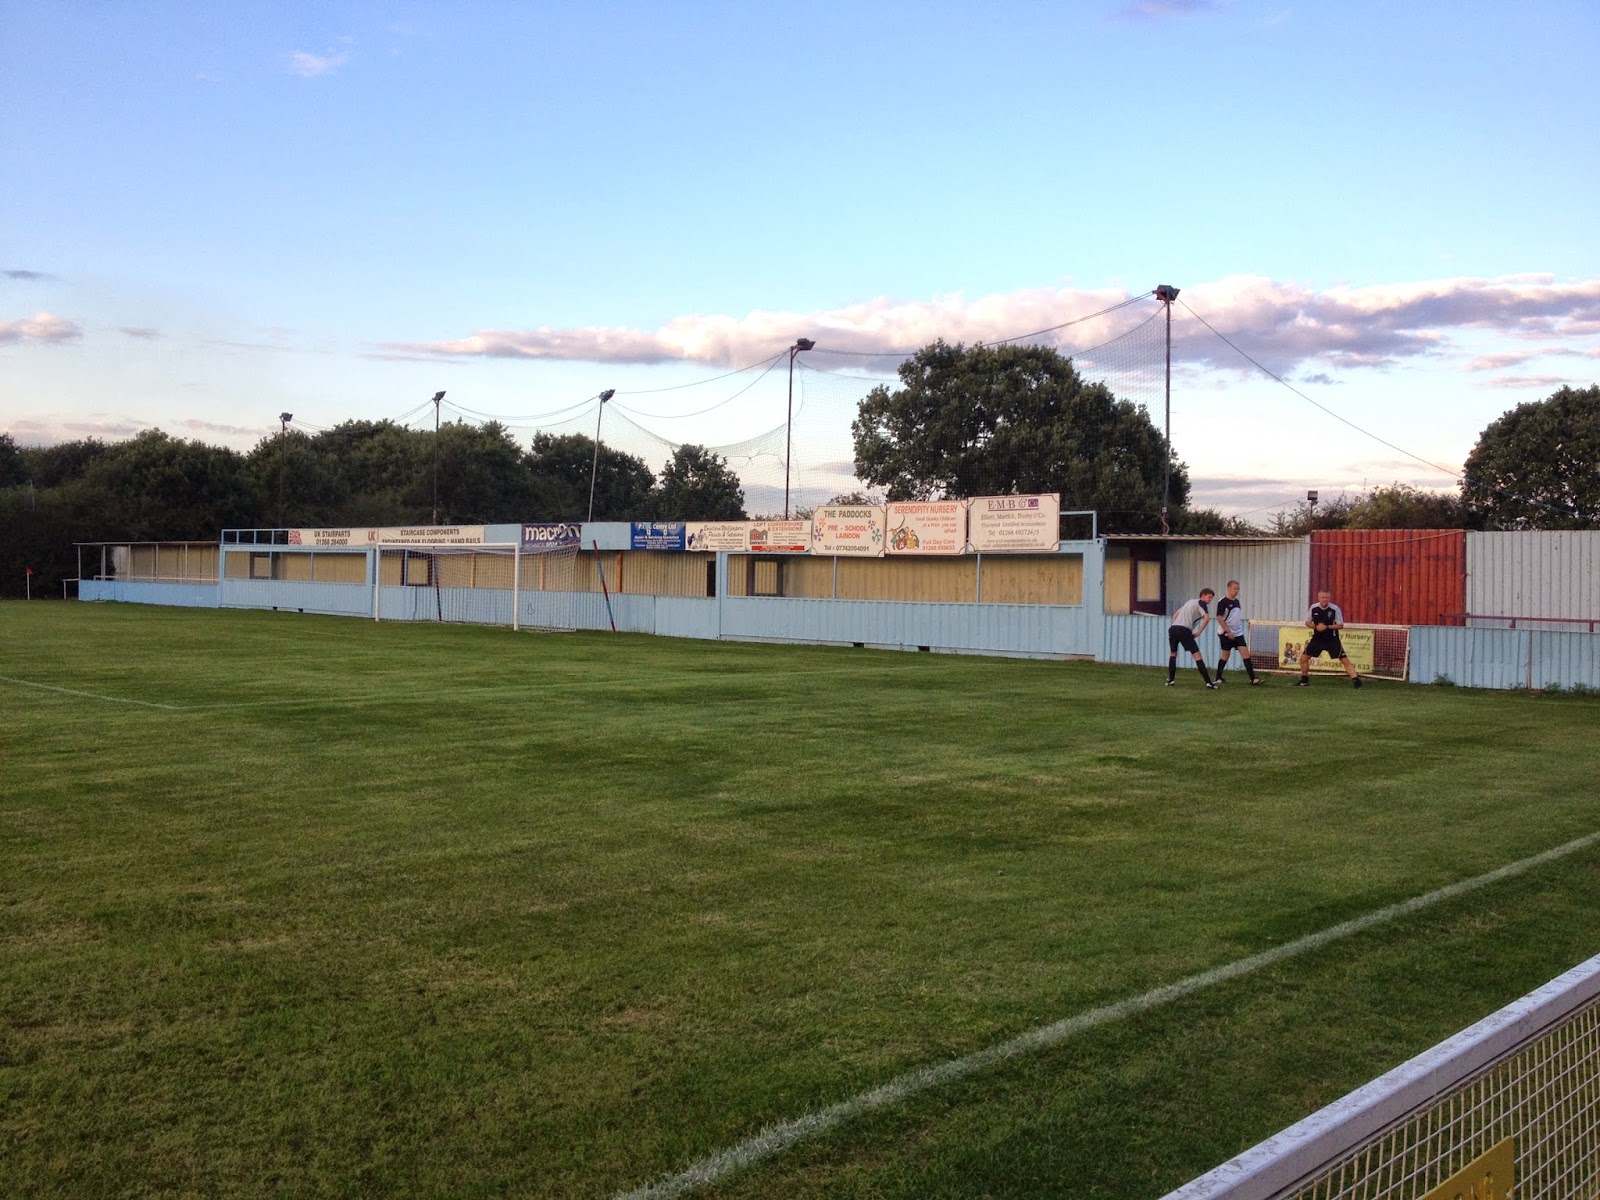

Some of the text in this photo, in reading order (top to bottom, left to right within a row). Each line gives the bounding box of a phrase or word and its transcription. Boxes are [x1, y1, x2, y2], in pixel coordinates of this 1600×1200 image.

[894, 505, 958, 514] SERENDIPITY NURSERY
[368, 530, 376, 541] UK
[525, 523, 580, 540] macron
